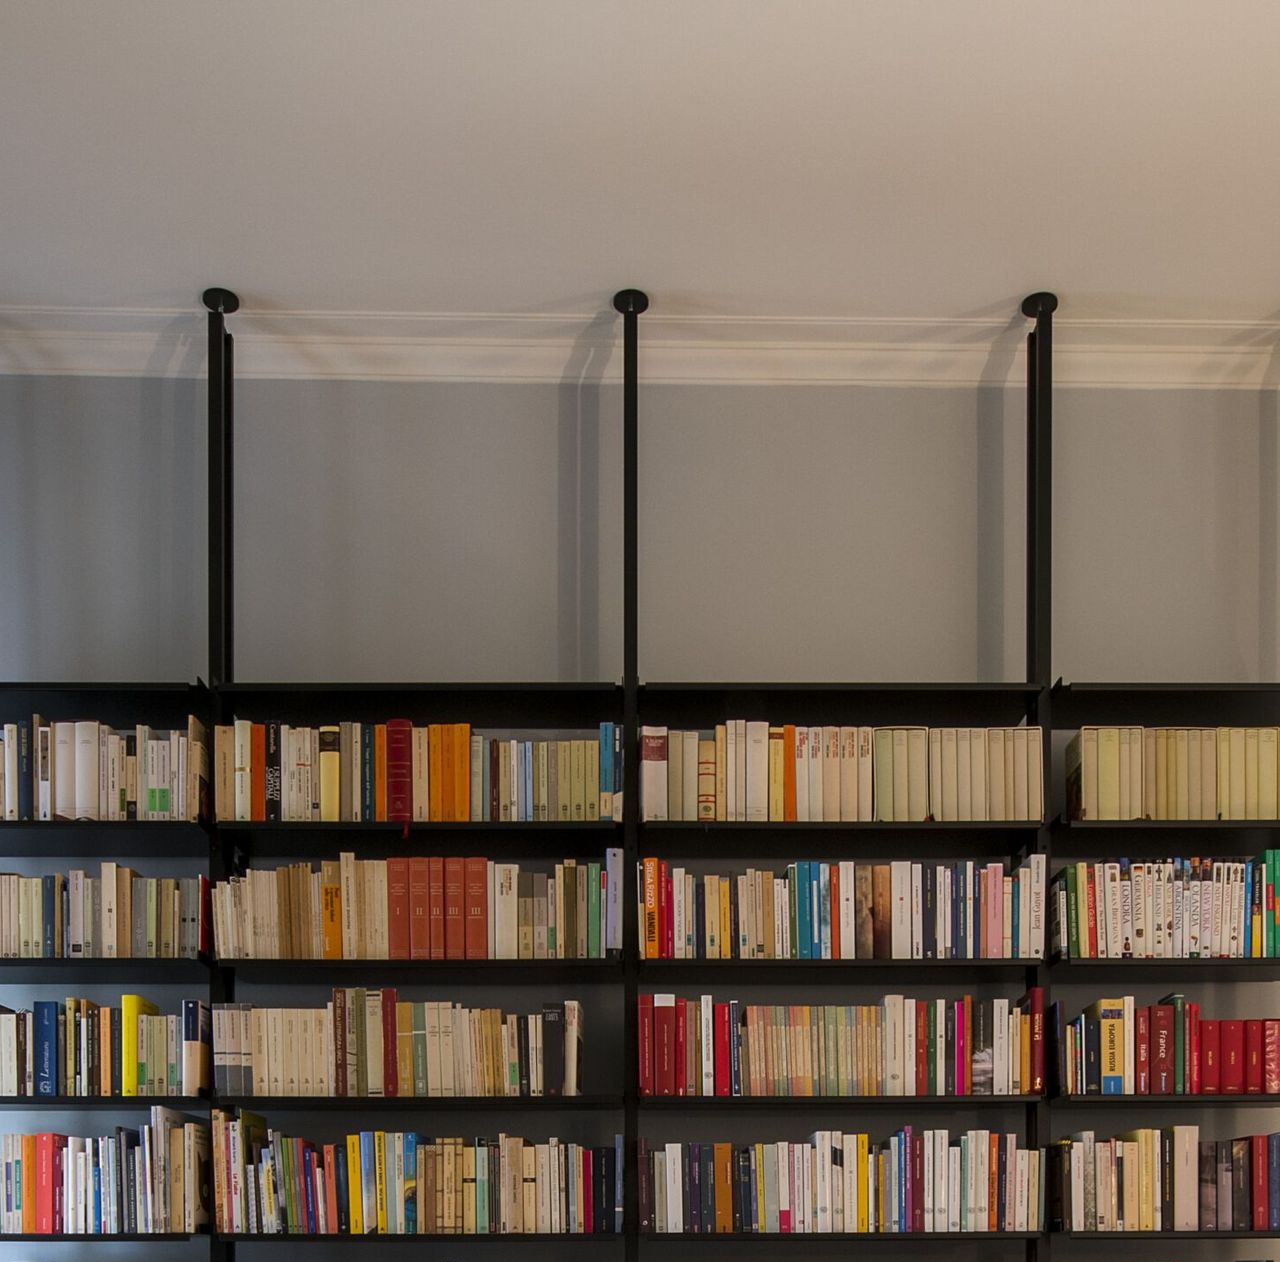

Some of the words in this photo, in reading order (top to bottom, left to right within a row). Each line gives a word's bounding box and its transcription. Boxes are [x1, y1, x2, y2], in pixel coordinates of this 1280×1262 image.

[1031, 891, 1043, 913] Guyot
[1122, 884, 1130, 924] LONDRA
[1134, 875, 1143, 921] GERMANIA
[1192, 885, 1200, 927] OLANDA
[1032, 914, 1040, 929] Jean
[1202, 907, 1210, 933] YORK
[1160, 1030, 1168, 1058] France
